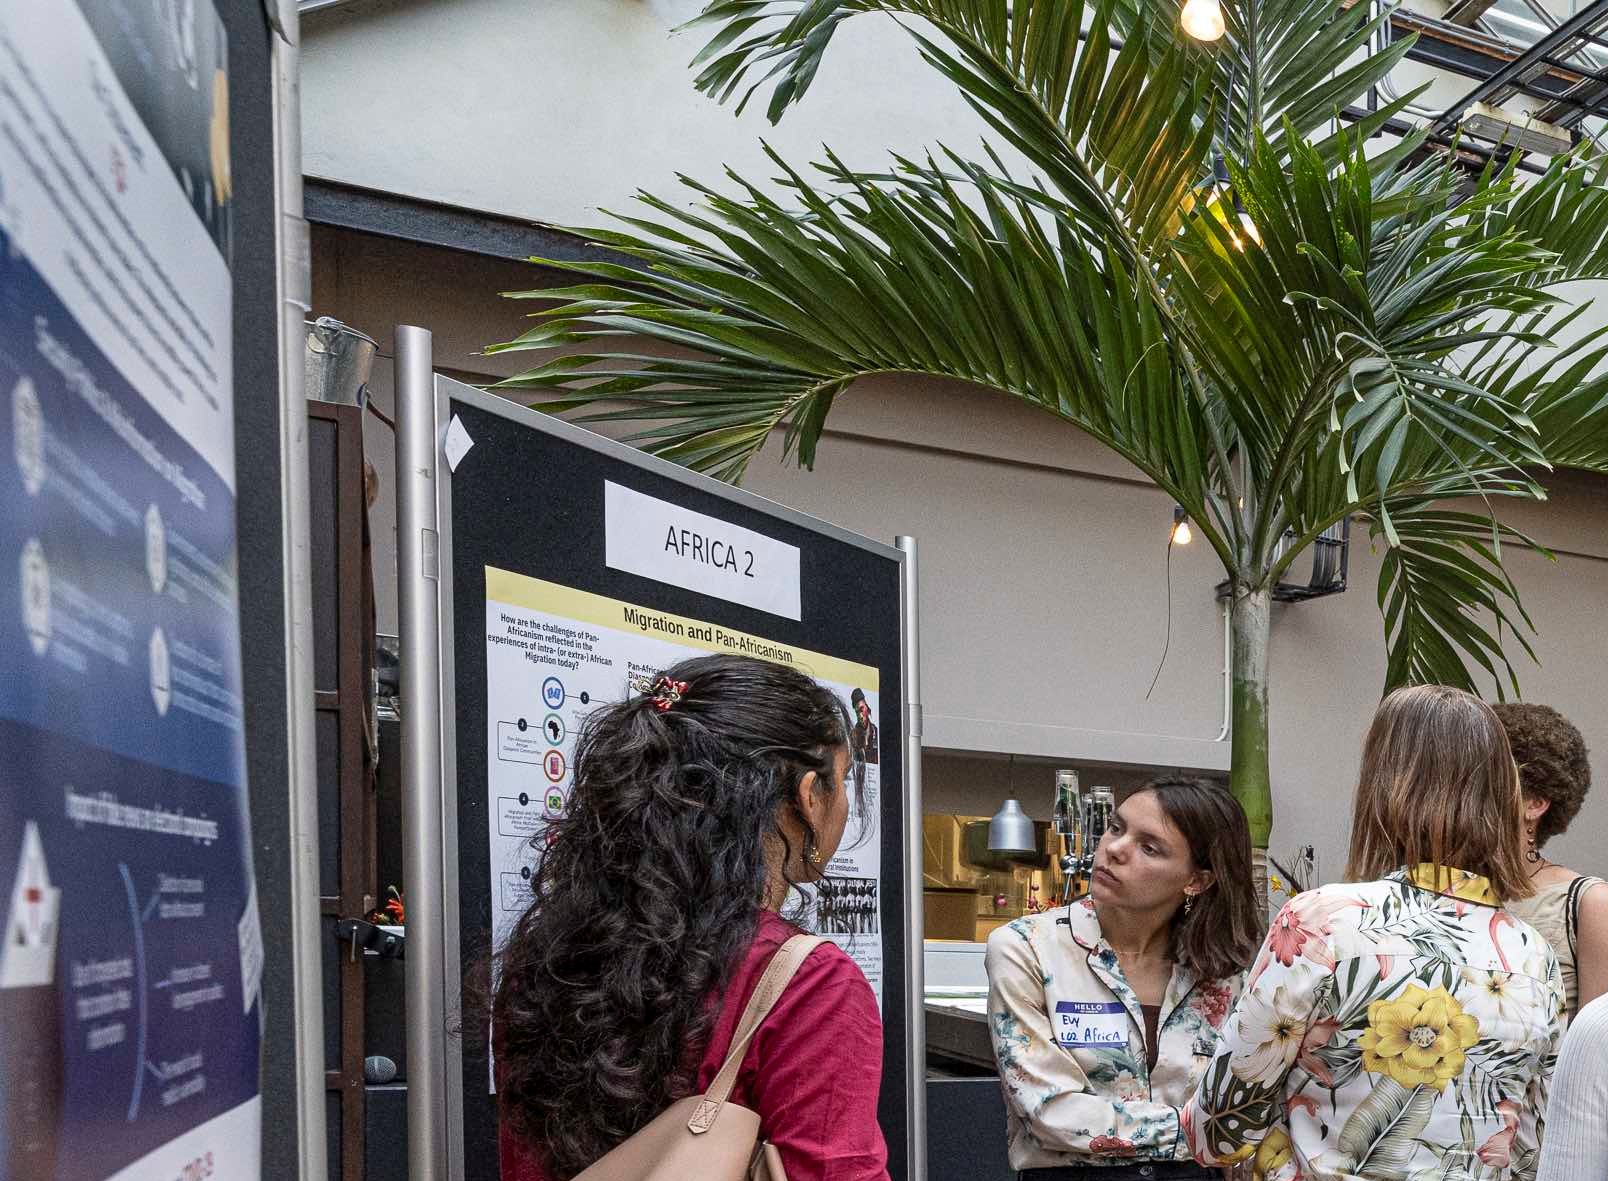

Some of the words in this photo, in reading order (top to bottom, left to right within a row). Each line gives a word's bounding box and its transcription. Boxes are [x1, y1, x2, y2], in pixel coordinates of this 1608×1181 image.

[664, 525, 738, 573] AFRICA
[744, 550, 754, 578] 2
[500, 613, 516, 624] How
[517, 619, 529, 627] are
[529, 619, 541, 630] the
[542, 622, 576, 638] challenges
[577, 631, 584, 640] of
[585, 632, 600, 643] Pan-
[507, 626, 544, 641] Africanism
[545, 635, 575, 647] reflected
[575, 640, 582, 649] in
[582, 642, 593, 652] the
[623, 606, 684, 637] Migration
[687, 627, 712, 642] and
[715, 629, 793, 664] Pan-Africanism
[487, 634, 528, 649] experiences
[529, 641, 537, 650] of
[537, 642, 556, 654] intra-
[557, 646, 567, 657] (or
[590, 654, 613, 666] African
[525, 651, 557, 665] Migration
[557, 659, 580, 671] today?
[1074, 1003, 1103, 1011] HELLO
